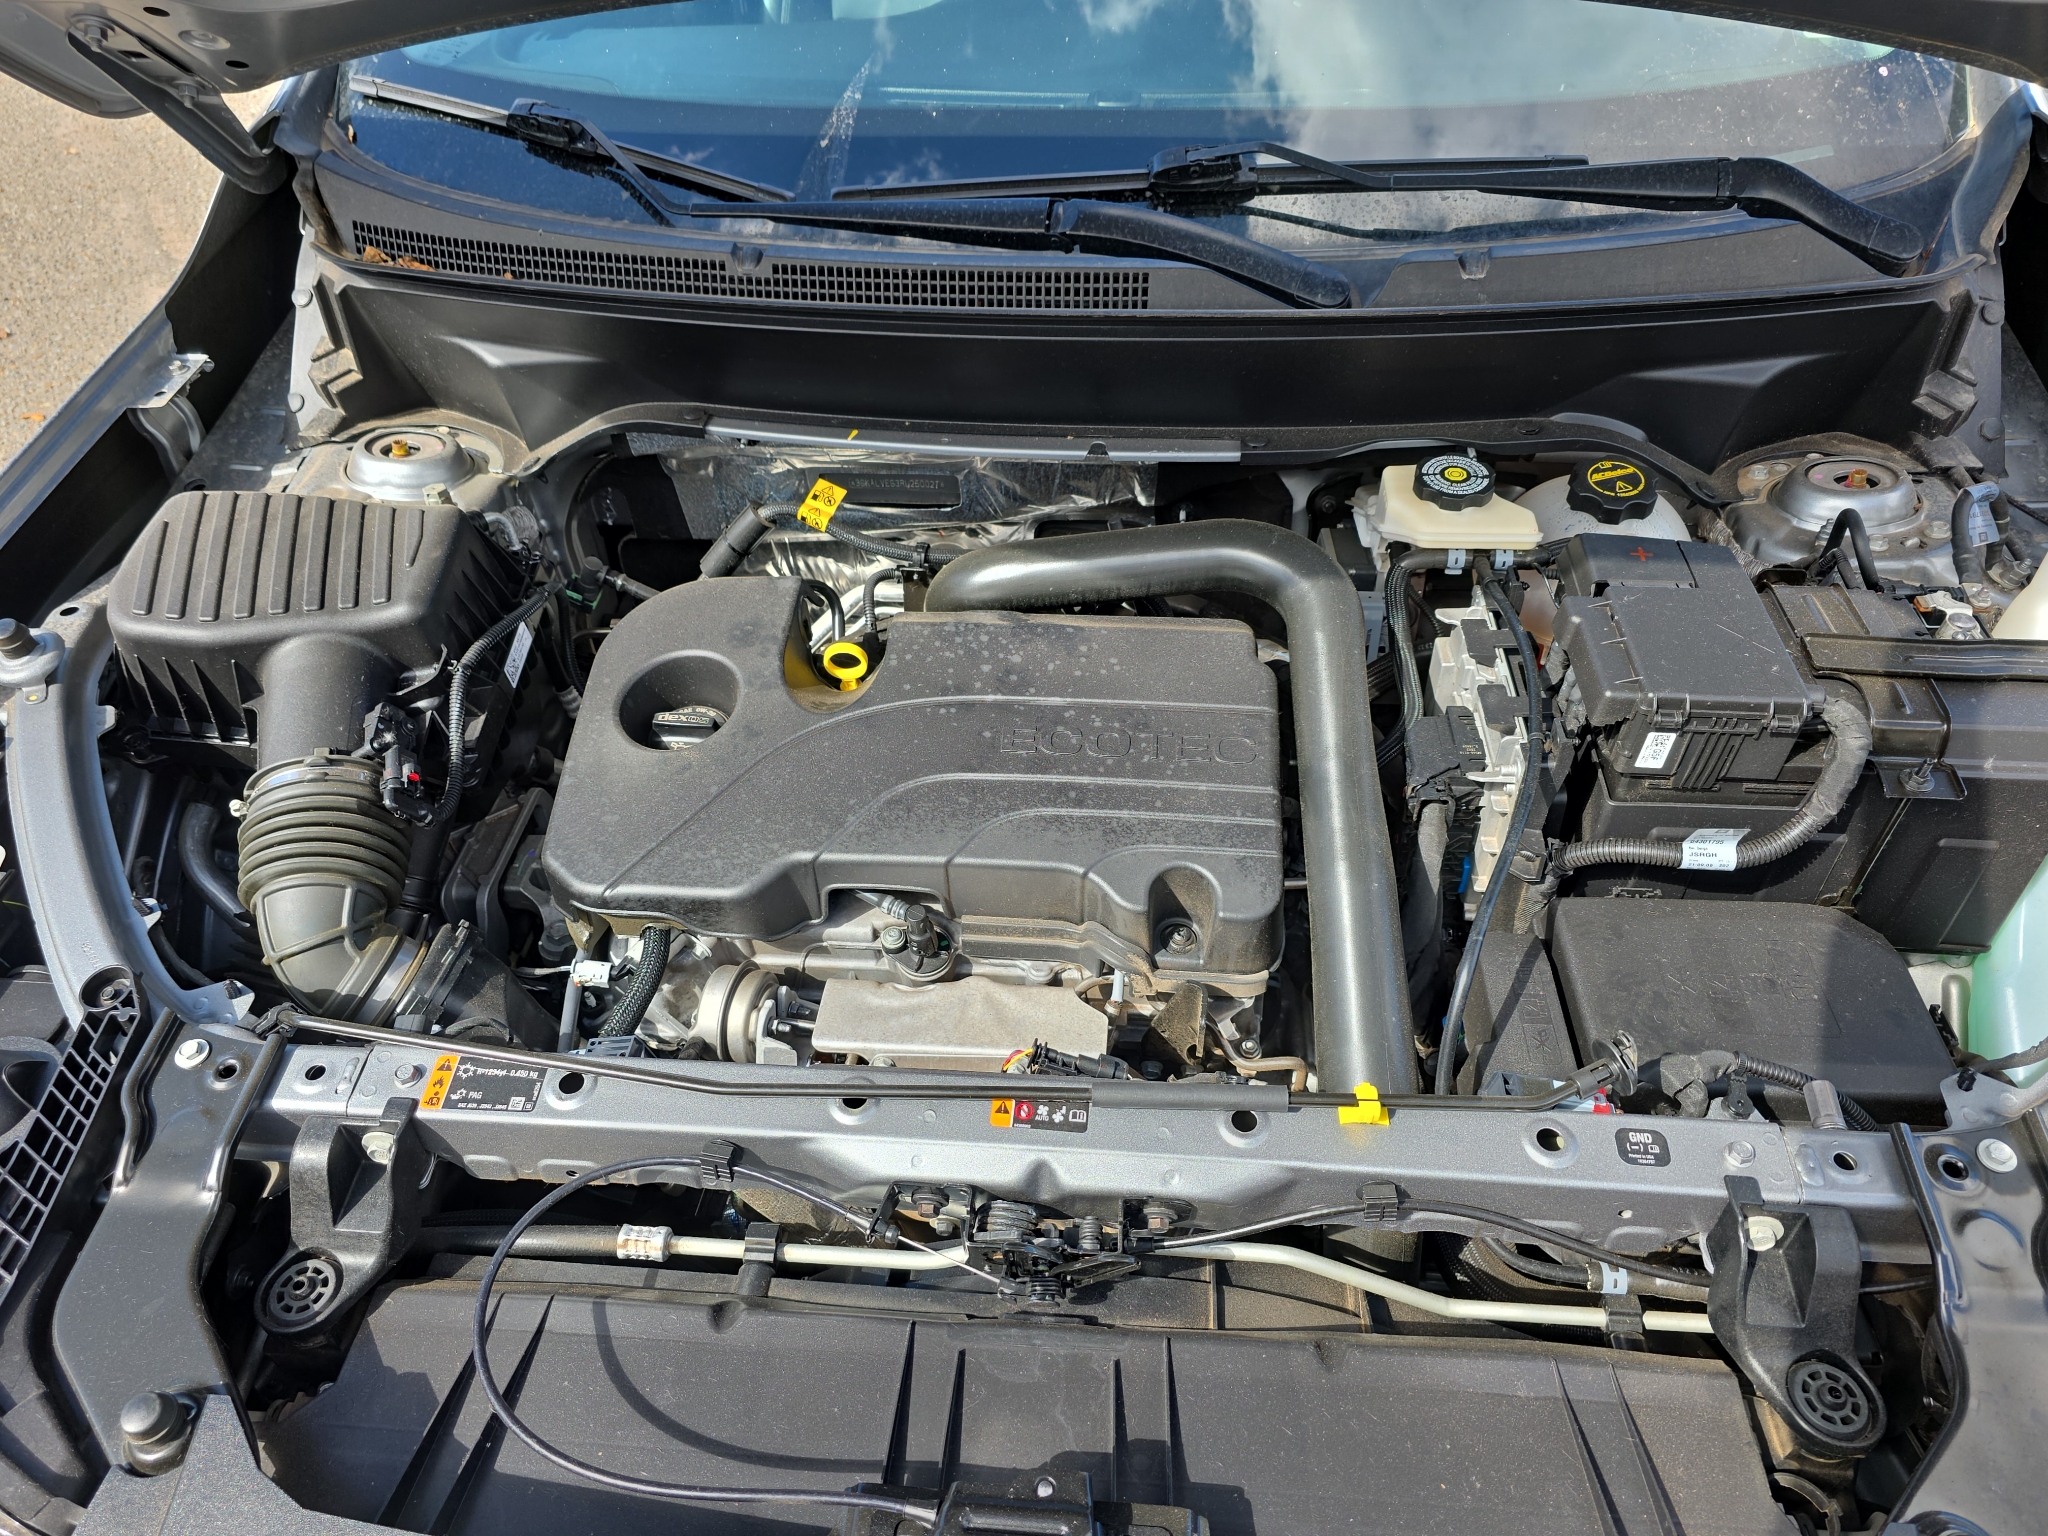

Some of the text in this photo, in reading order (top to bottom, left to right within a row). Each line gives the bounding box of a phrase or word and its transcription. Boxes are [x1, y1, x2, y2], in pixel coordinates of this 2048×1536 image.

[1591, 467, 1634, 481] ACDelco
[658, 713, 710, 724] dexos
[1000, 726, 1258, 764] ECOTEC
[468, 1091, 483, 1099] PAG
[1034, 1114, 1050, 1122] AUTO
[1628, 1131, 1653, 1144] GND
